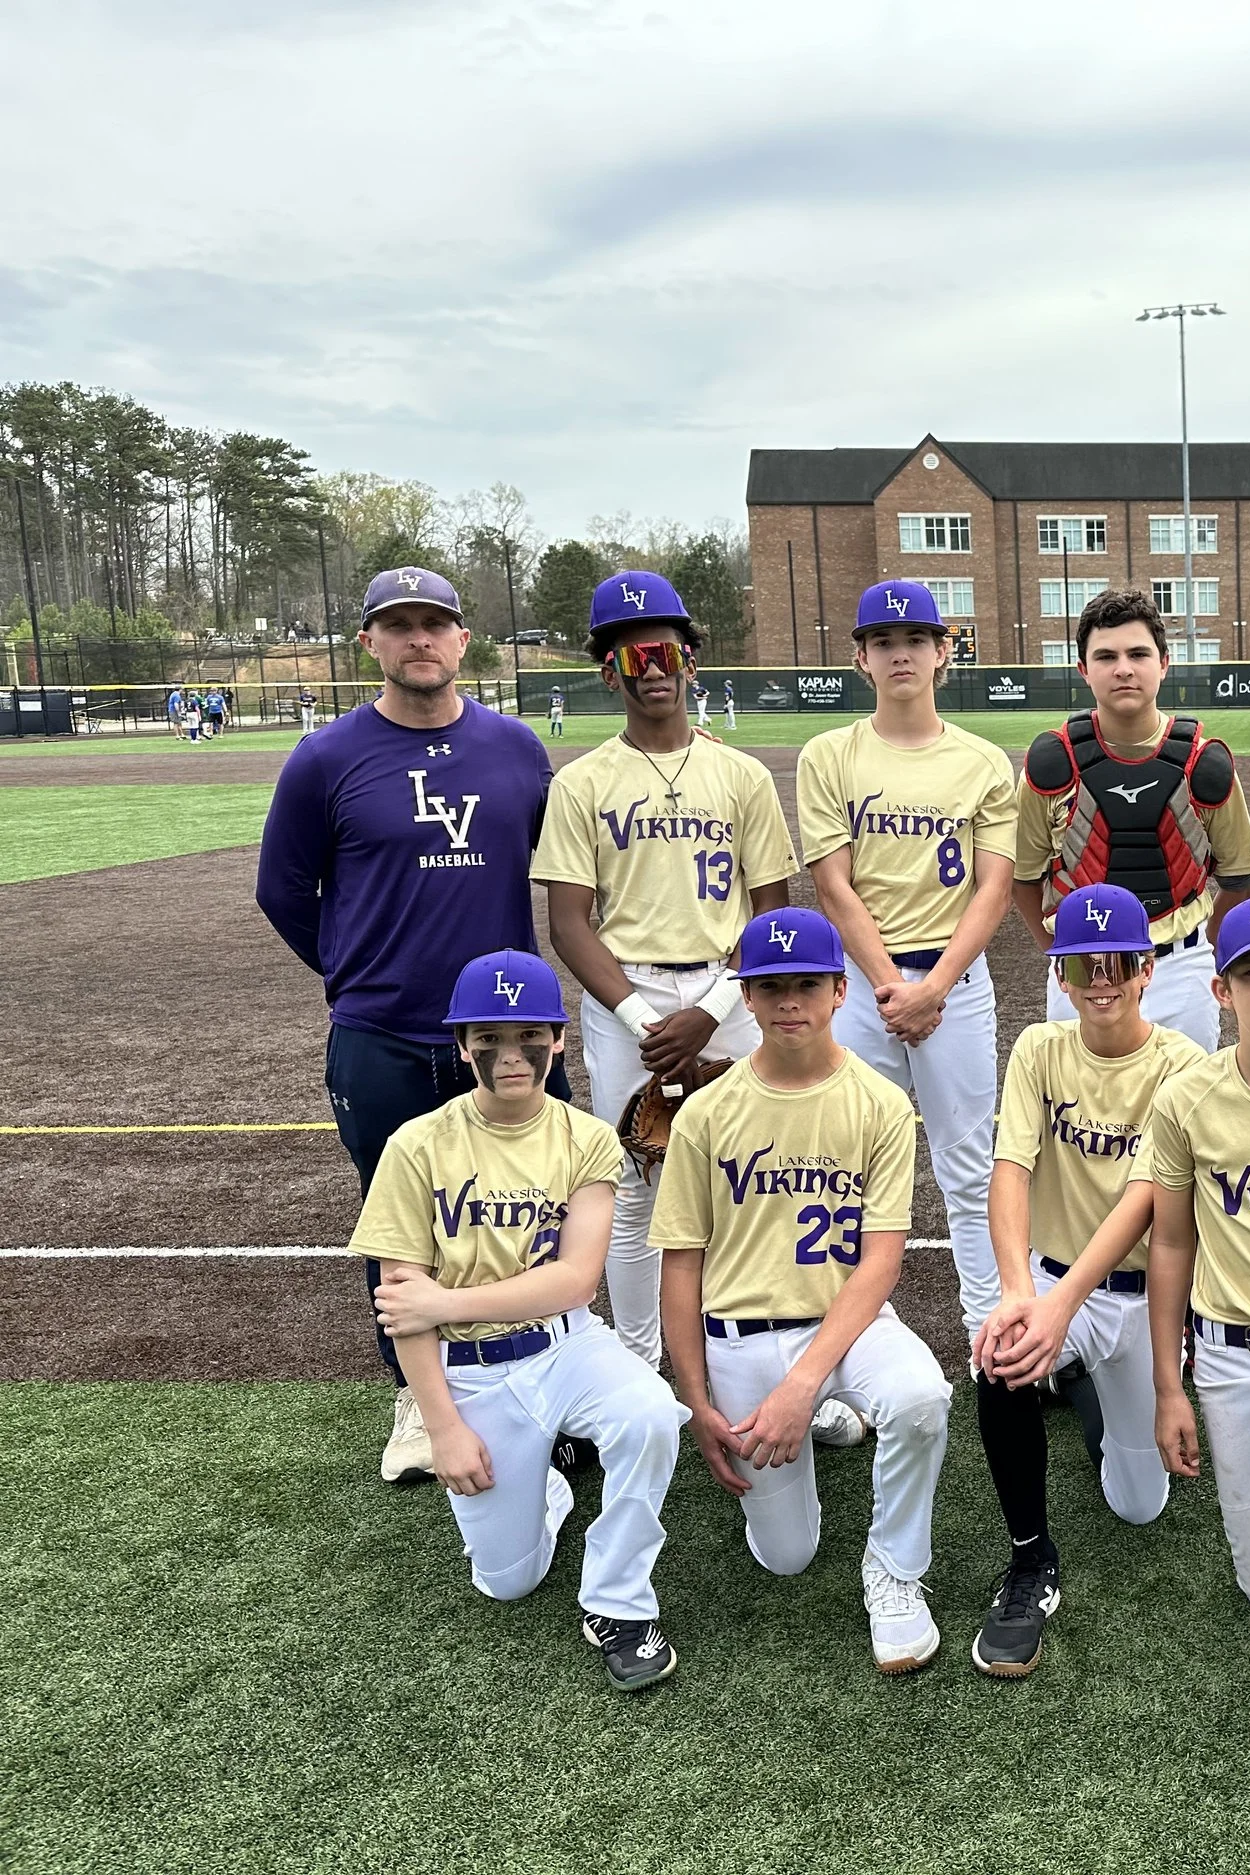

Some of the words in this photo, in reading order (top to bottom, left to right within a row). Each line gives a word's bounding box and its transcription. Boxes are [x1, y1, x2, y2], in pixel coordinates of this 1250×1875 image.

[397, 571, 422, 591] LV
[620, 582, 647, 610] LV
[885, 589, 910, 617] LV
[798, 677, 843, 688] KAPLAN
[988, 685, 1026, 693] VOYLES
[407, 769, 481, 849] LV
[655, 805, 714, 818] LAKESIDE
[887, 801, 946, 815] LAKESIDE
[419, 853, 486, 869] BASEBALL
[937, 837, 966, 888] 8
[693, 850, 733, 901] 13
[1086, 899, 1113, 932] LV
[768, 920, 798, 953] LV
[493, 970, 525, 1006] LV
[1078, 1114, 1140, 1133] LAKESIDE
[718, 1137, 863, 1205] VIKINGS
[778, 1155, 842, 1168] LAKESIDE
[486, 1187, 549, 1200] AKESIDE
[795, 1204, 863, 1266] 23
